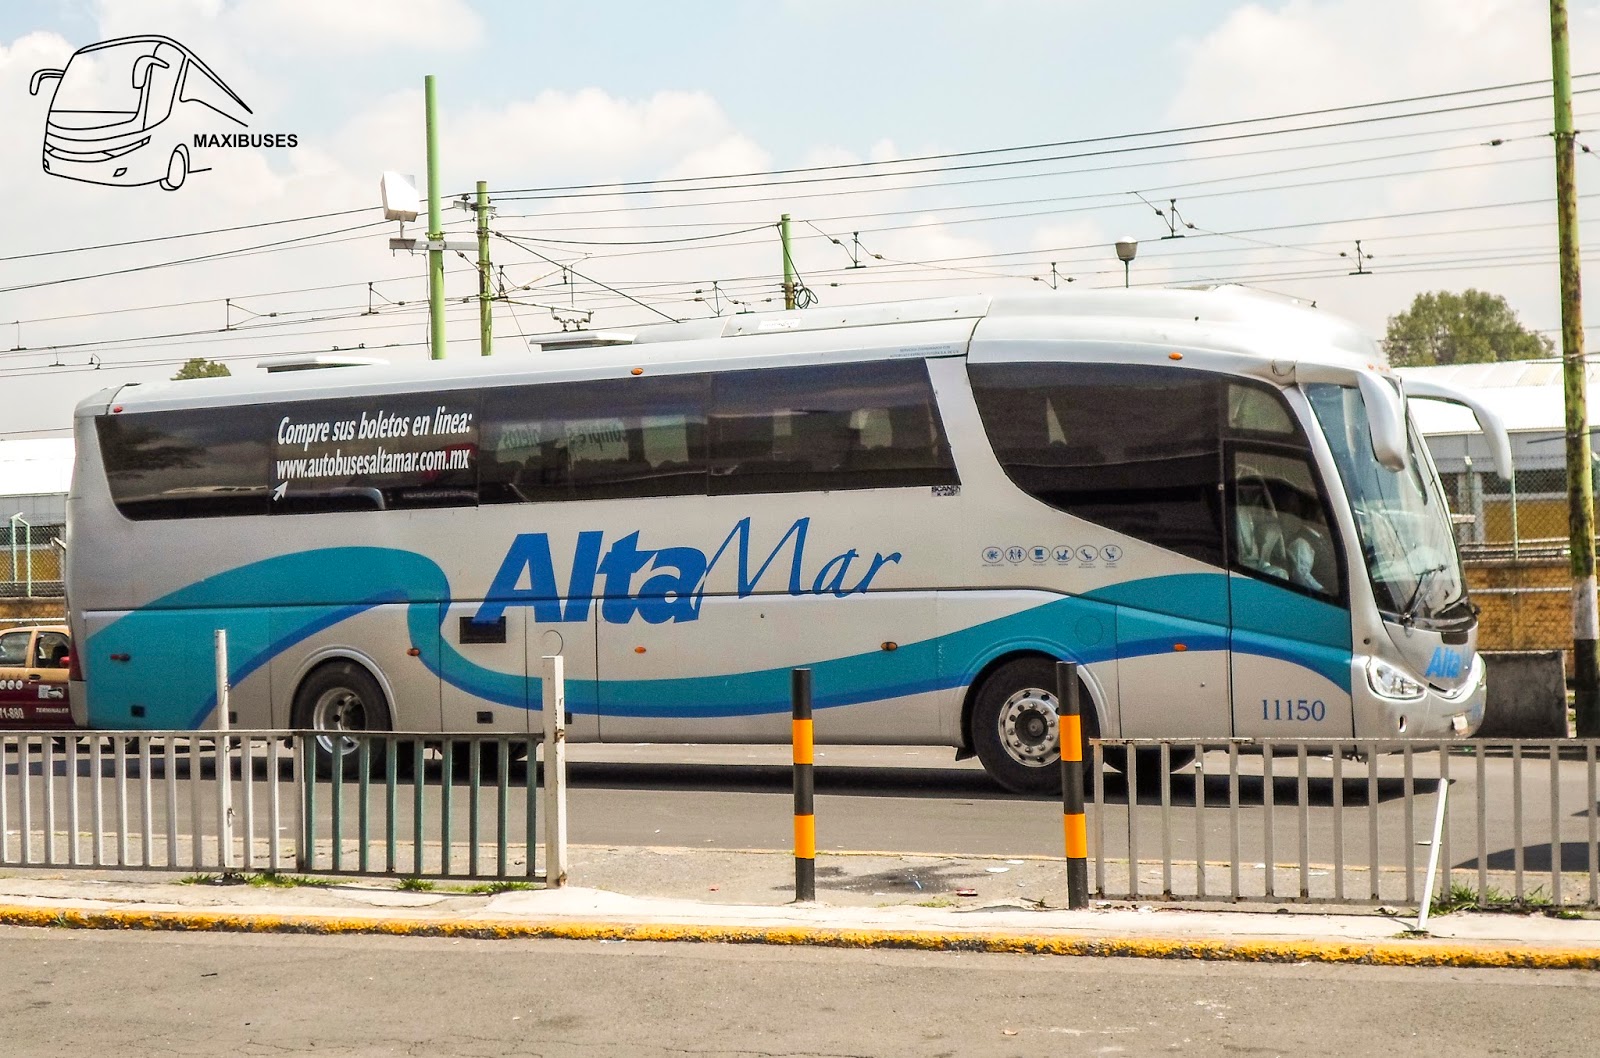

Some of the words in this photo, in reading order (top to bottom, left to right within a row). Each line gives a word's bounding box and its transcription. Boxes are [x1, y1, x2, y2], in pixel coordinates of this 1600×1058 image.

[277, 416, 330, 451] Compre
[332, 419, 356, 441] sus
[358, 410, 409, 440] boletos
[412, 414, 431, 436] en
[276, 446, 471, 480] www.autobusesaltamar.com.mx
[1261, 699, 1326, 722] 11150
